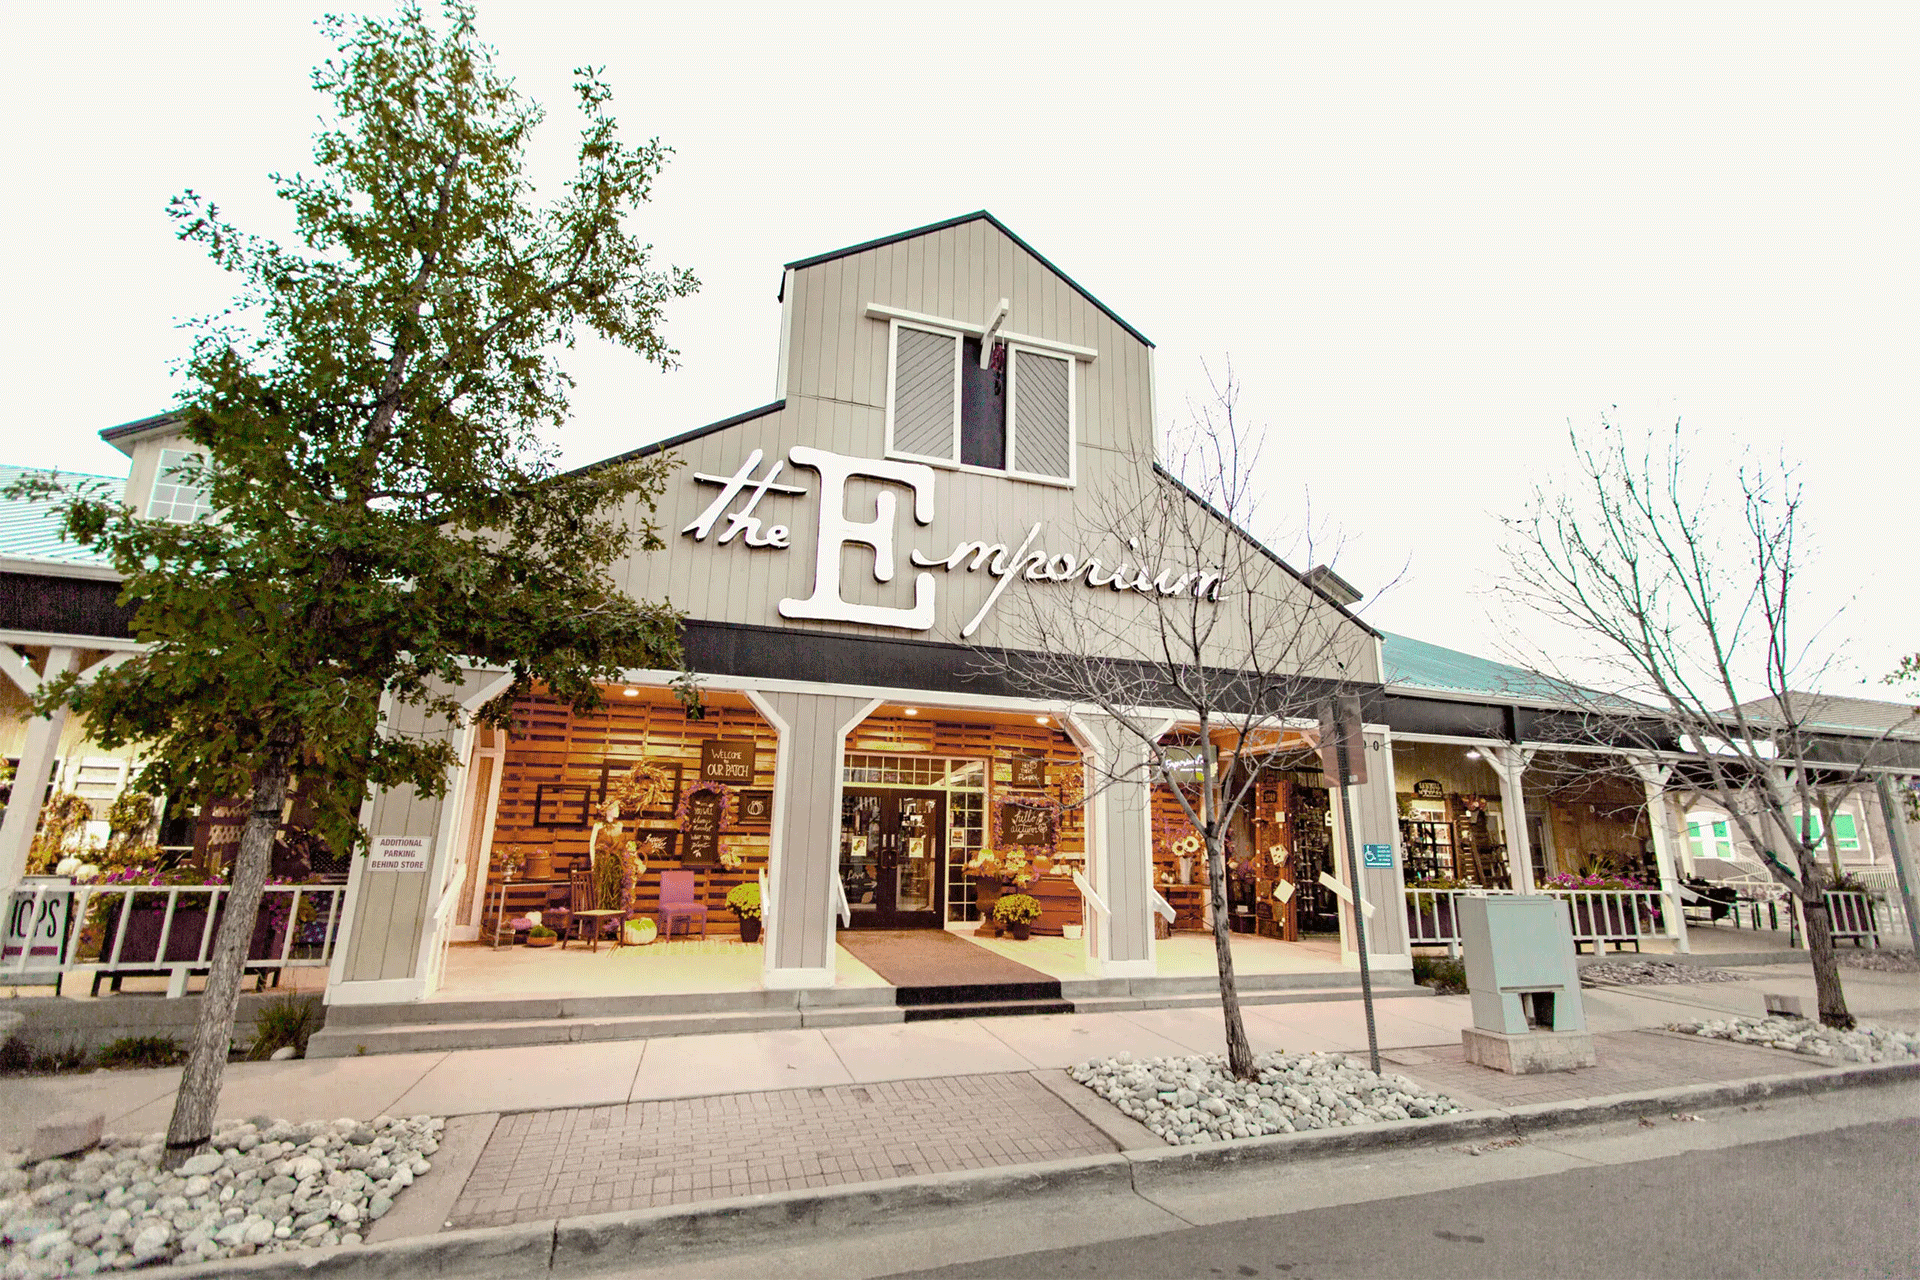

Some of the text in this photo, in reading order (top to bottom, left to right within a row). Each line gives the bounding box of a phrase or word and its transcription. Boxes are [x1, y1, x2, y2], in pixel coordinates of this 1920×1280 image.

[681, 448, 807, 549] the
[711, 748, 742, 760] WELCOME
[707, 763, 749, 777] OUR PATCH
[1014, 809, 1037, 823] hello
[1010, 823, 1038, 834] autumn
